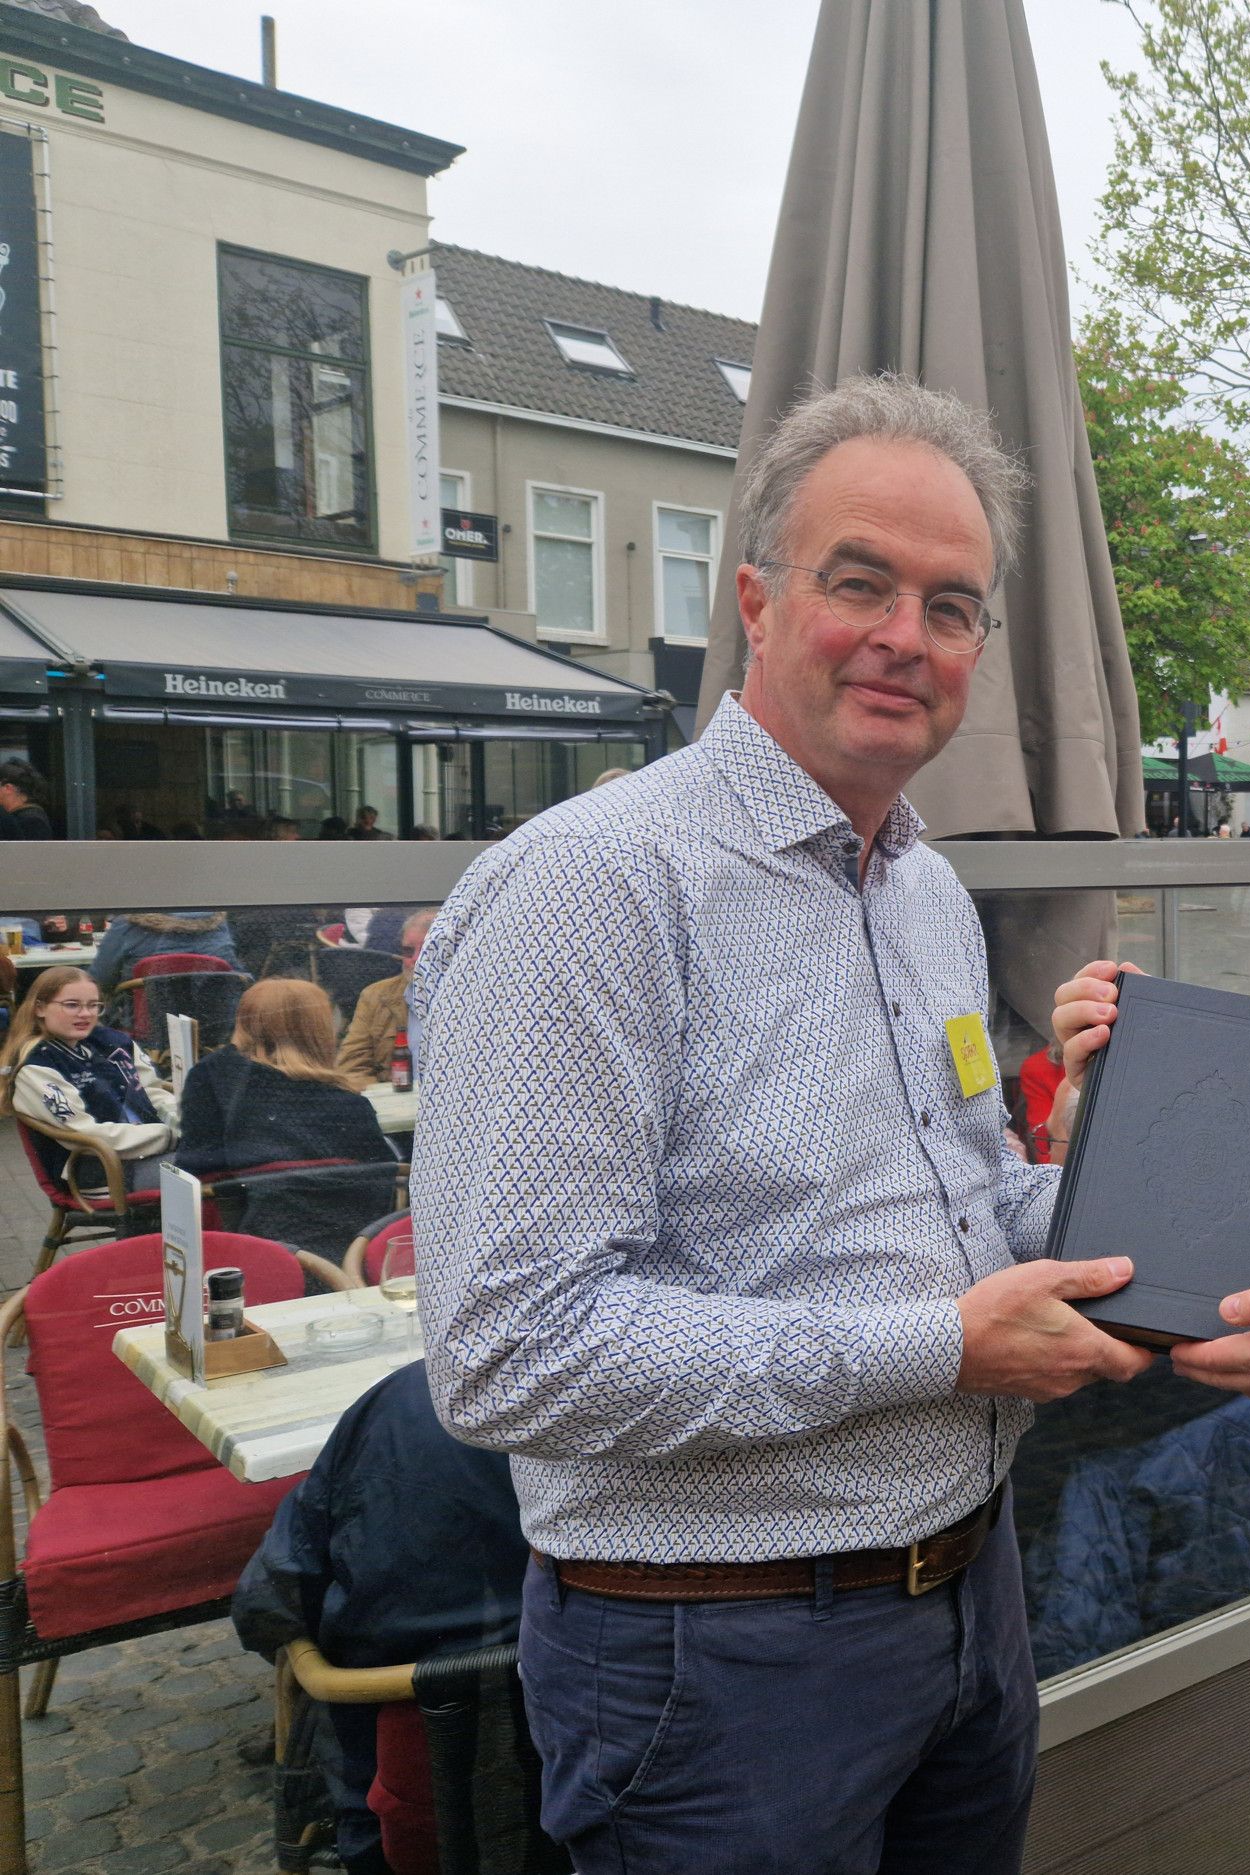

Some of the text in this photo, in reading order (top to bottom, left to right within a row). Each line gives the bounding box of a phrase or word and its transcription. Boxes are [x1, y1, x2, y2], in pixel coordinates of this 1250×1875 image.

[413, 328, 429, 500] COMMERCE
[164, 673, 286, 699] Heineken
[365, 688, 432, 702] COMMERCE
[505, 692, 601, 714] Heineken
